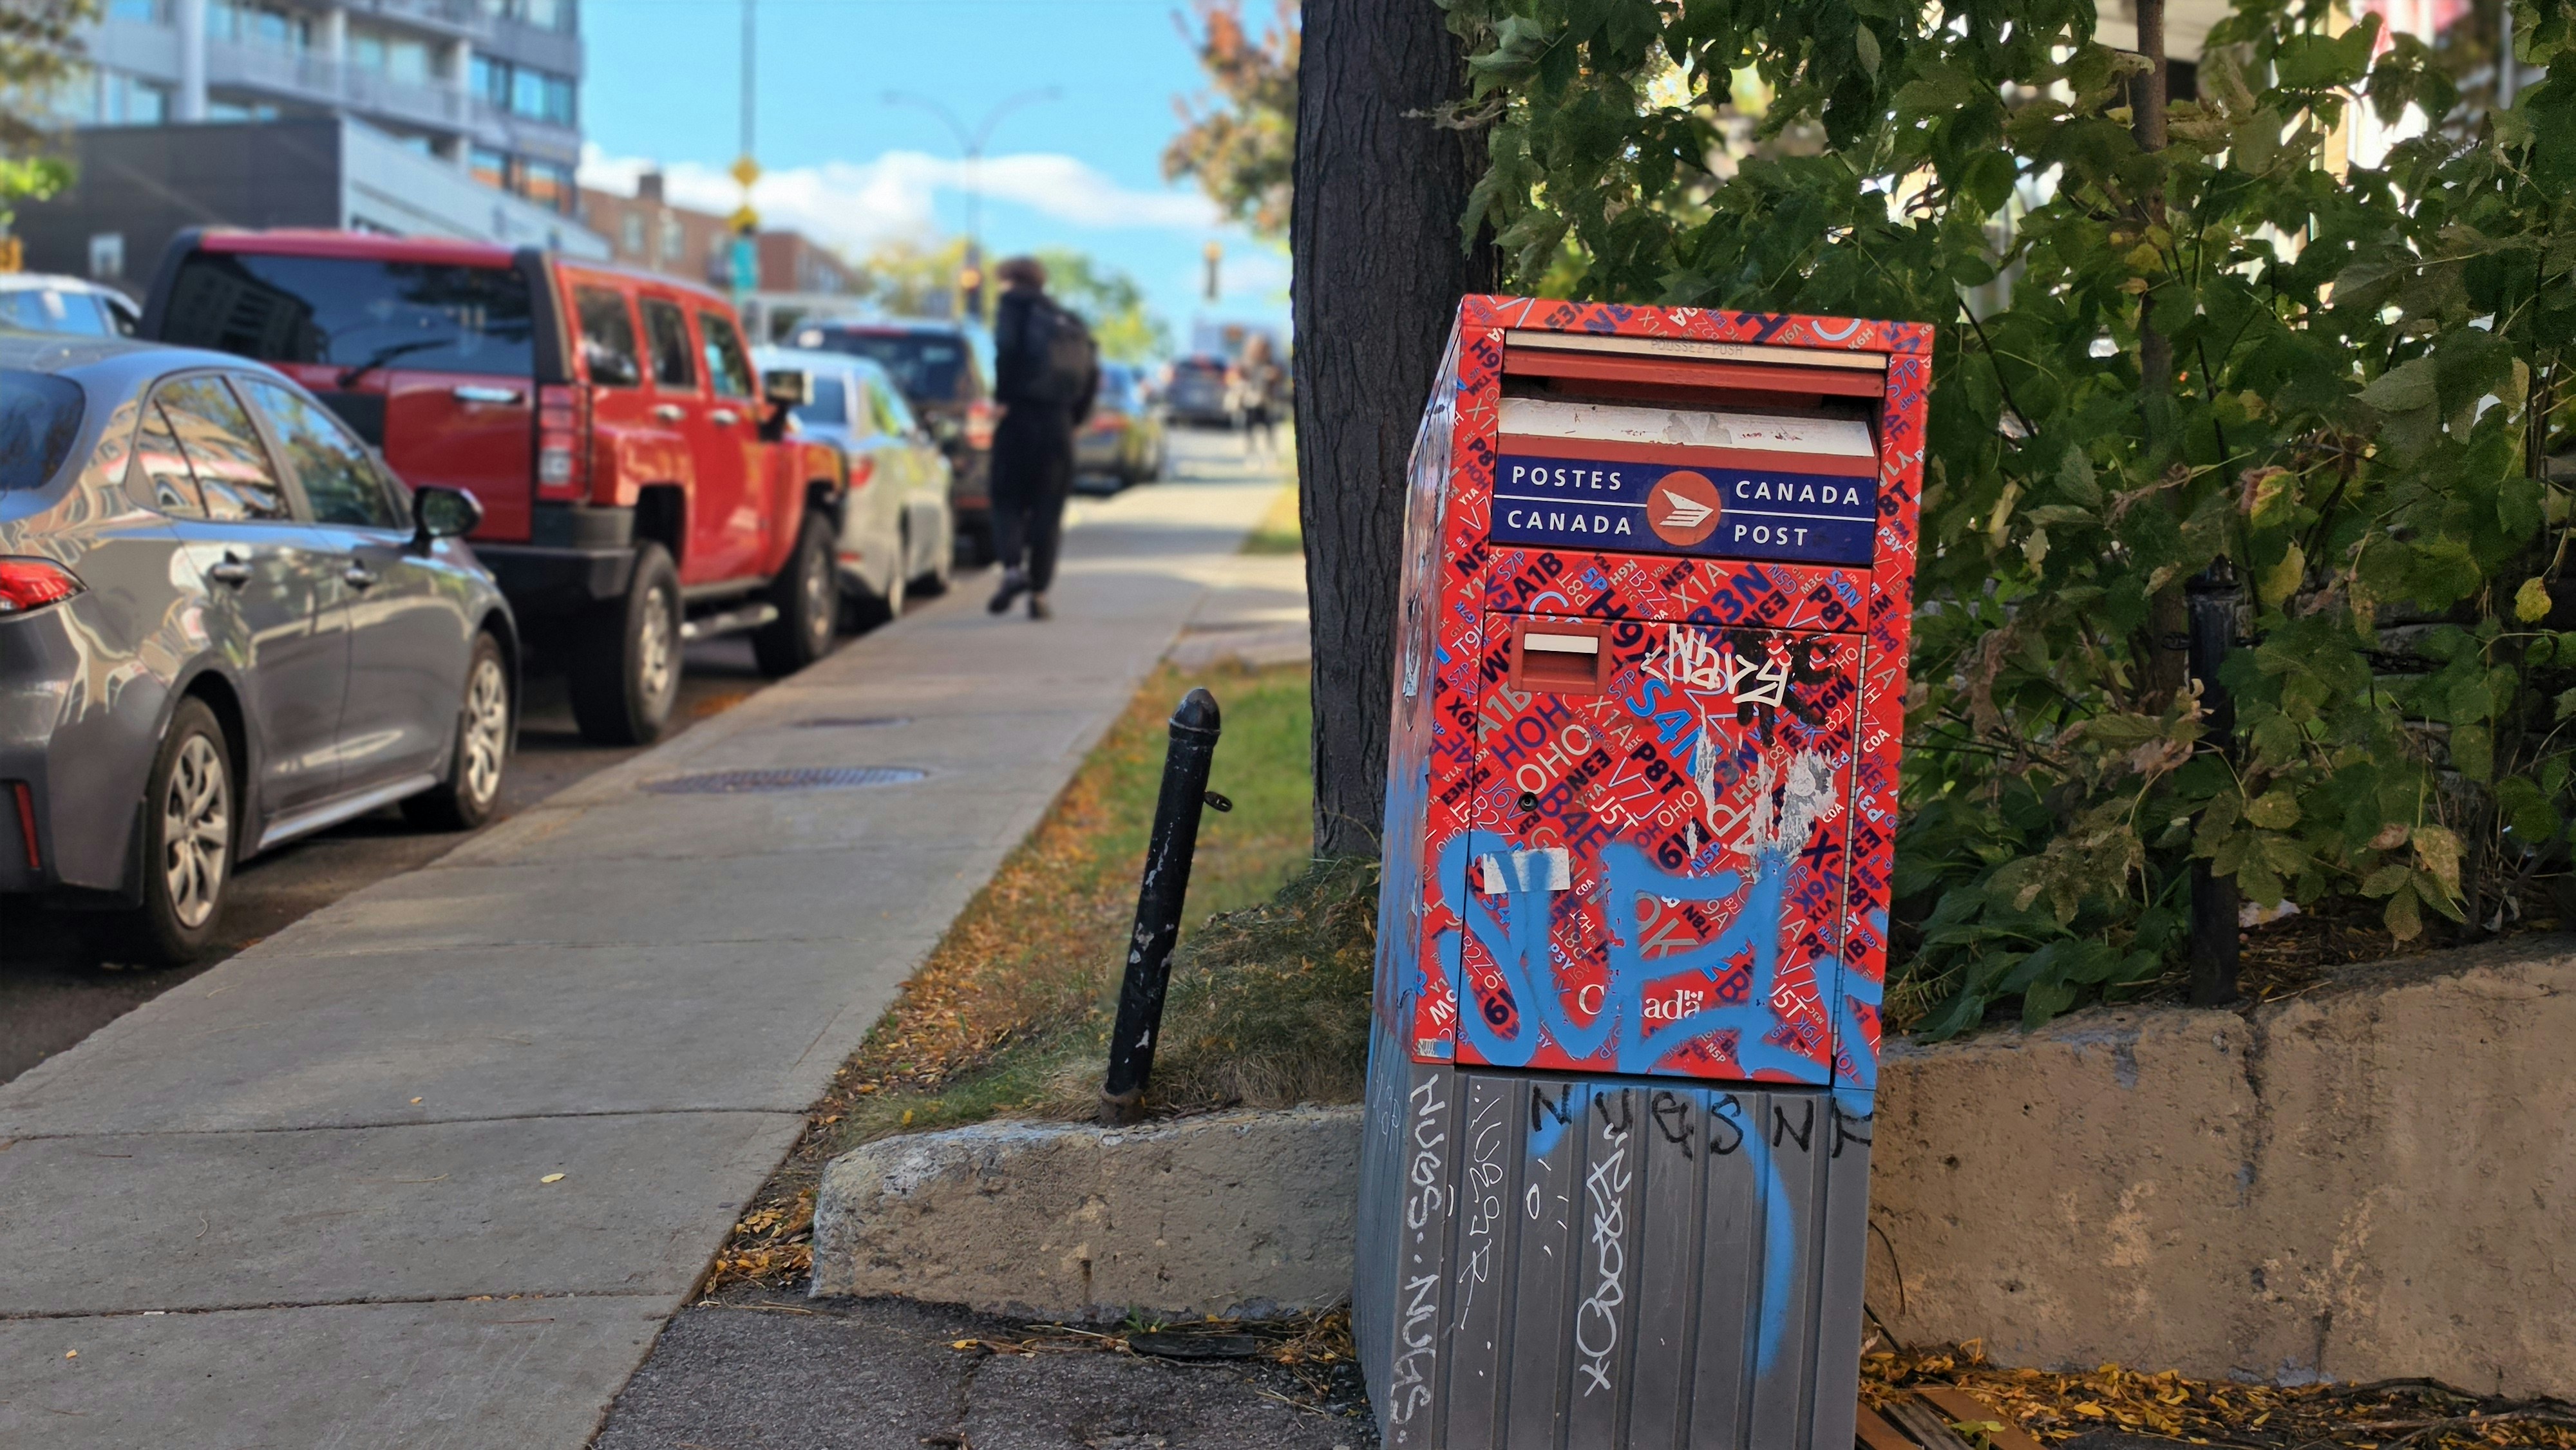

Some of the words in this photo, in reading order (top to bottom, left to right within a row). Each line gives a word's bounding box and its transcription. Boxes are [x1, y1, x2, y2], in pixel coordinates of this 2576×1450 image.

[1848, 327, 1875, 350] K6H
[1458, 487, 1479, 507] Y1A
[1512, 466, 1622, 491] POSTES
[1735, 480, 1861, 506] CANADA
[1507, 509, 1633, 536] CANADA
[1734, 524, 1808, 547] POST
[1877, 526, 1904, 553] P3Y
[1497, 551, 1525, 581] S7P
[1513, 552, 1564, 604] A1B
[1609, 558, 1638, 587] K6H
[1651, 563, 1670, 579] V9L
[1556, 571, 1593, 608] P8T
[1620, 583, 1638, 603] T1C
[1628, 569, 1668, 611] B2Z
[1669, 561, 1730, 614] X1A
[1799, 572, 1824, 595] M3C
[1824, 569, 1863, 609] S4N
[1806, 583, 1860, 632] P8T
[1607, 668, 1636, 701] S7P
[1574, 706, 1591, 726] T1C
[1584, 695, 1634, 748] X1A
[1624, 734, 1643, 753] M3C
[1442, 765, 1463, 783] Y1A
[1565, 746, 1613, 793] E3N
[1629, 740, 1685, 795] P8T
[1591, 796, 1639, 836] J5T
[1690, 841, 1721, 872] N5P
[1548, 942, 1576, 970] P3Y
[1578, 983, 1702, 1020] Cada
[1768, 982, 1808, 1019] J5T
[1705, 1042, 1721, 1062] N5P
